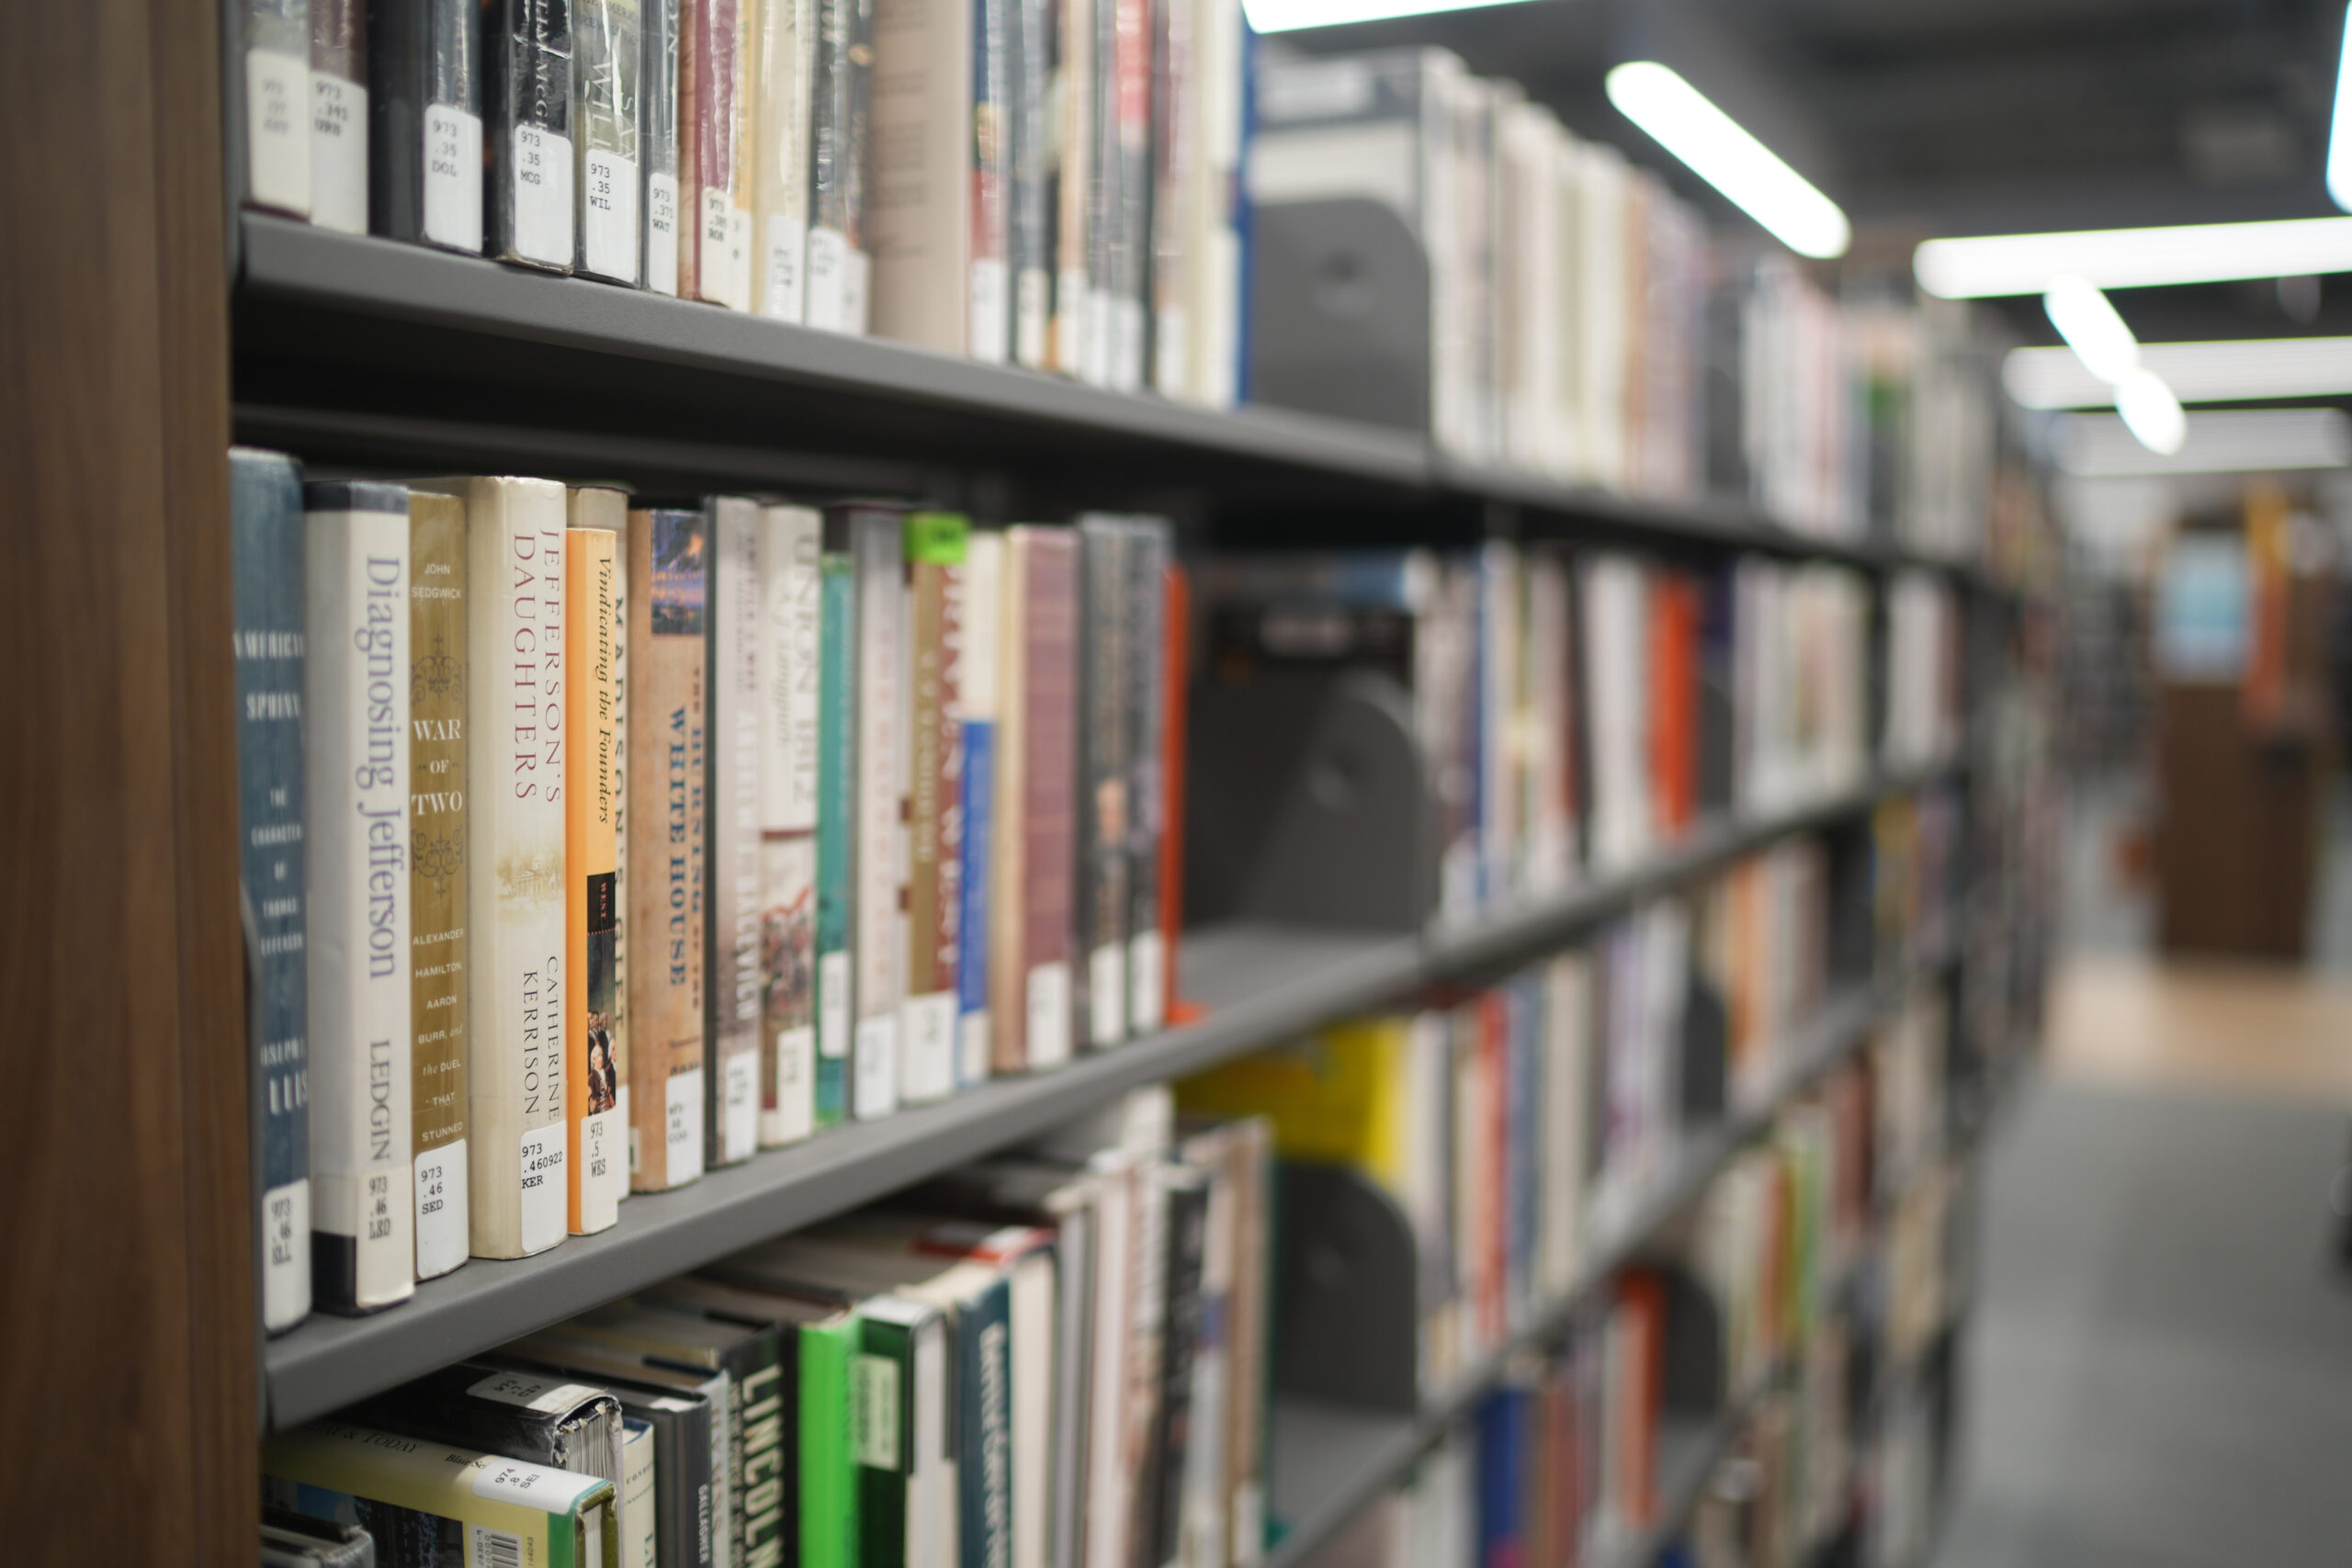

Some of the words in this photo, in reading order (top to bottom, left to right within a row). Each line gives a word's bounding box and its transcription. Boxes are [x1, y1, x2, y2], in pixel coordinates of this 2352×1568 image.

[433, 119, 458, 137] 973
[521, 130, 541, 147] 973
[435, 142, 458, 157] .35
[522, 152, 541, 166] .35
[431, 160, 458, 177] DOL
[520, 169, 542, 186] MCG
[590, 164, 611, 178] 973
[592, 180, 611, 194] .35
[653, 187, 670, 202] 973
[590, 196, 612, 211] WIL
[424, 564, 451, 574] JOHN
[412, 587, 461, 599] SEDGWICK
[594, 557, 611, 684] Vindicating
[354, 555, 401, 792] Diagnosing
[514, 533, 537, 799] DAUGHTERS
[540, 527, 560, 803] JEFFERSON'S
[598, 690, 611, 720] the
[413, 719, 461, 741] WAR
[615, 595, 624, 885] MADISON'S
[429, 760, 449, 774] OF
[669, 705, 686, 843] WHITE
[598, 728, 611, 825] Founders
[412, 791, 462, 816] TWO
[356, 801, 405, 980] Jefferson
[669, 854, 686, 987] HOUSE
[260, 931, 302, 956] EFFERSON
[413, 928, 464, 946] ALEXANDER
[426, 995, 458, 1010] AARON
[418, 1030, 447, 1044] BURR,
[449, 1022, 463, 1037] and
[547, 955, 560, 1121] CATHERINE
[523, 970, 539, 1115] KERRISON
[260, 1038, 300, 1066] OSEPH
[422, 1063, 439, 1077] the
[440, 1060, 461, 1073] DUEL
[370, 1040, 390, 1161] LEDGIN
[433, 1091, 455, 1106] THAT
[422, 1122, 464, 1142] STUNNED
[590, 1122, 603, 1139] 973
[522, 1143, 543, 1158] 973
[592, 1141, 599, 1157] .5
[524, 1151, 563, 1173] .460922
[591, 1158, 606, 1179] WES
[421, 1167, 443, 1182] 973
[521, 1175, 544, 1190] KER
[369, 1176, 388, 1194] 973
[424, 1182, 443, 1199] .46
[369, 1198, 388, 1218] .46
[422, 1199, 444, 1214] SED
[361, 1432, 423, 1454] TODAY
[445, 1454, 471, 1467] Blair
[743, 1363, 784, 1568] LINCOLN
[494, 1468, 515, 1483] 974
[510, 1477, 521, 1486] .8
[520, 1473, 541, 1488] SEI
[698, 1483, 710, 1564] GALLAGHER
